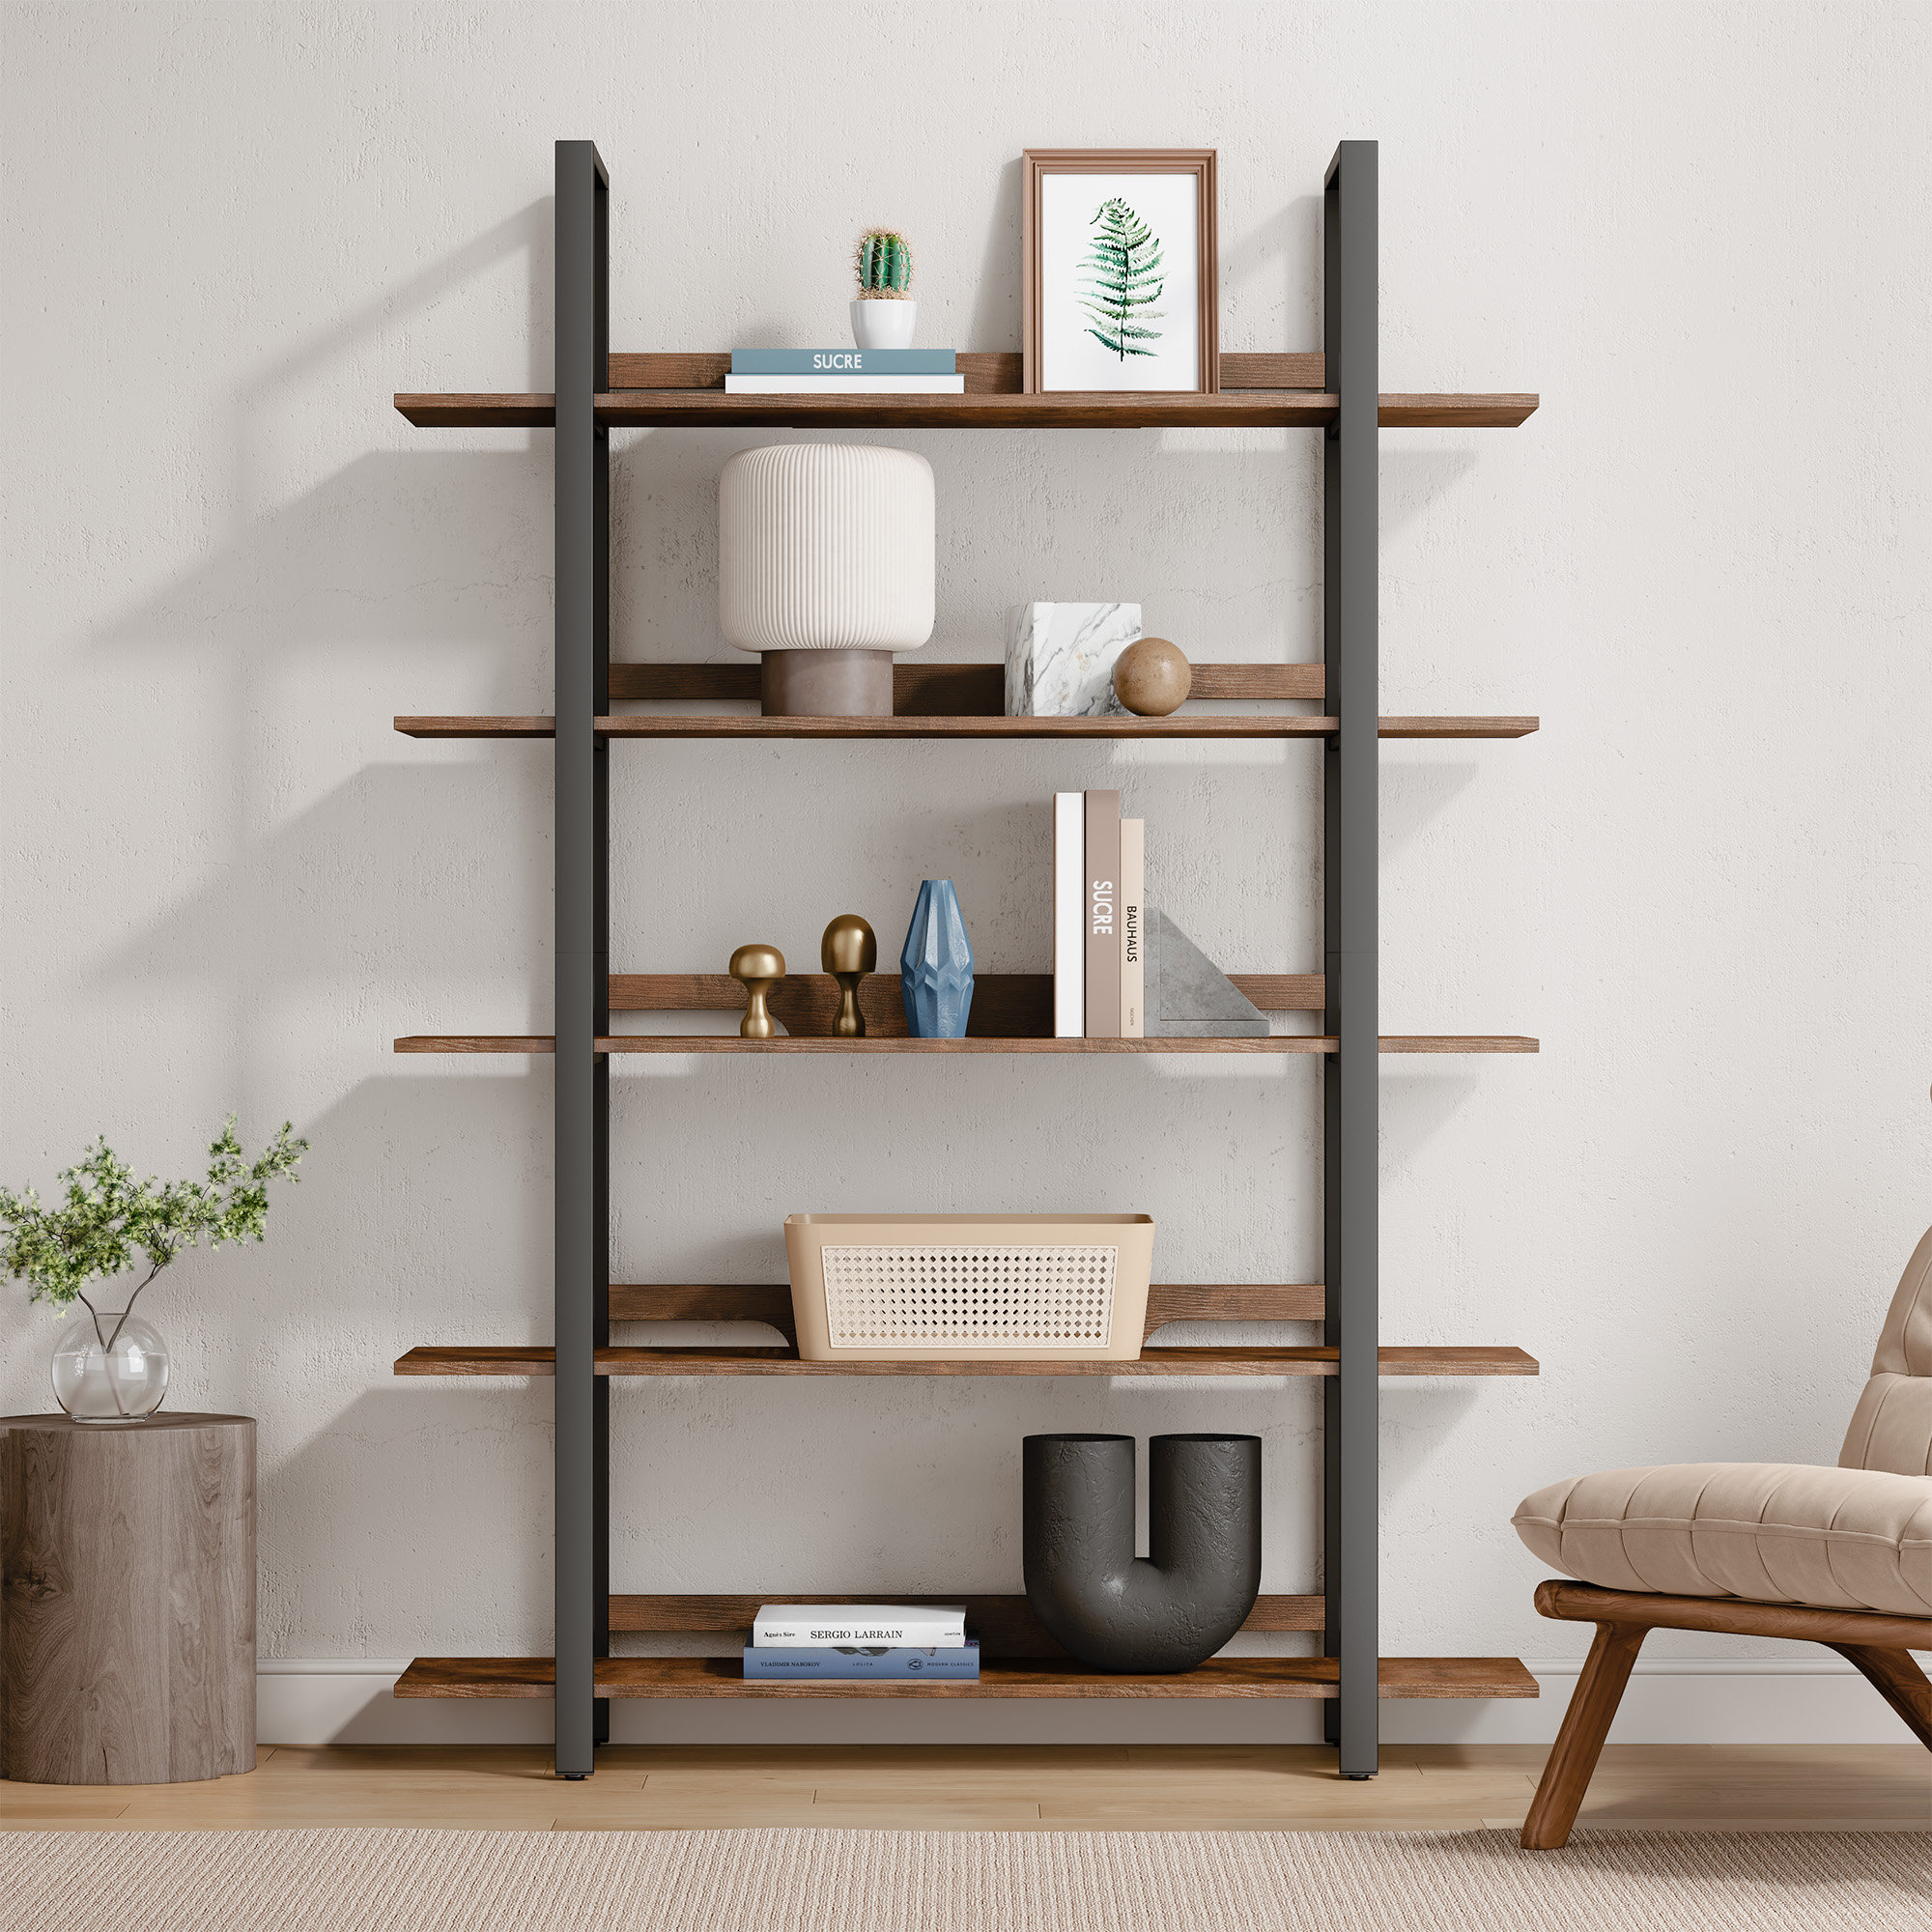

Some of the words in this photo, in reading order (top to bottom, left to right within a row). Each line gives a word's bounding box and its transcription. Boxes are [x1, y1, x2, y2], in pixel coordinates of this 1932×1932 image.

[812, 354, 863, 369] SUCRE
[1093, 880, 1113, 935] SUCRE
[1126, 905, 1138, 963] BAUHAUS
[810, 1630, 851, 1639] SERGIO
[854, 1630, 903, 1639] LARRAIN
